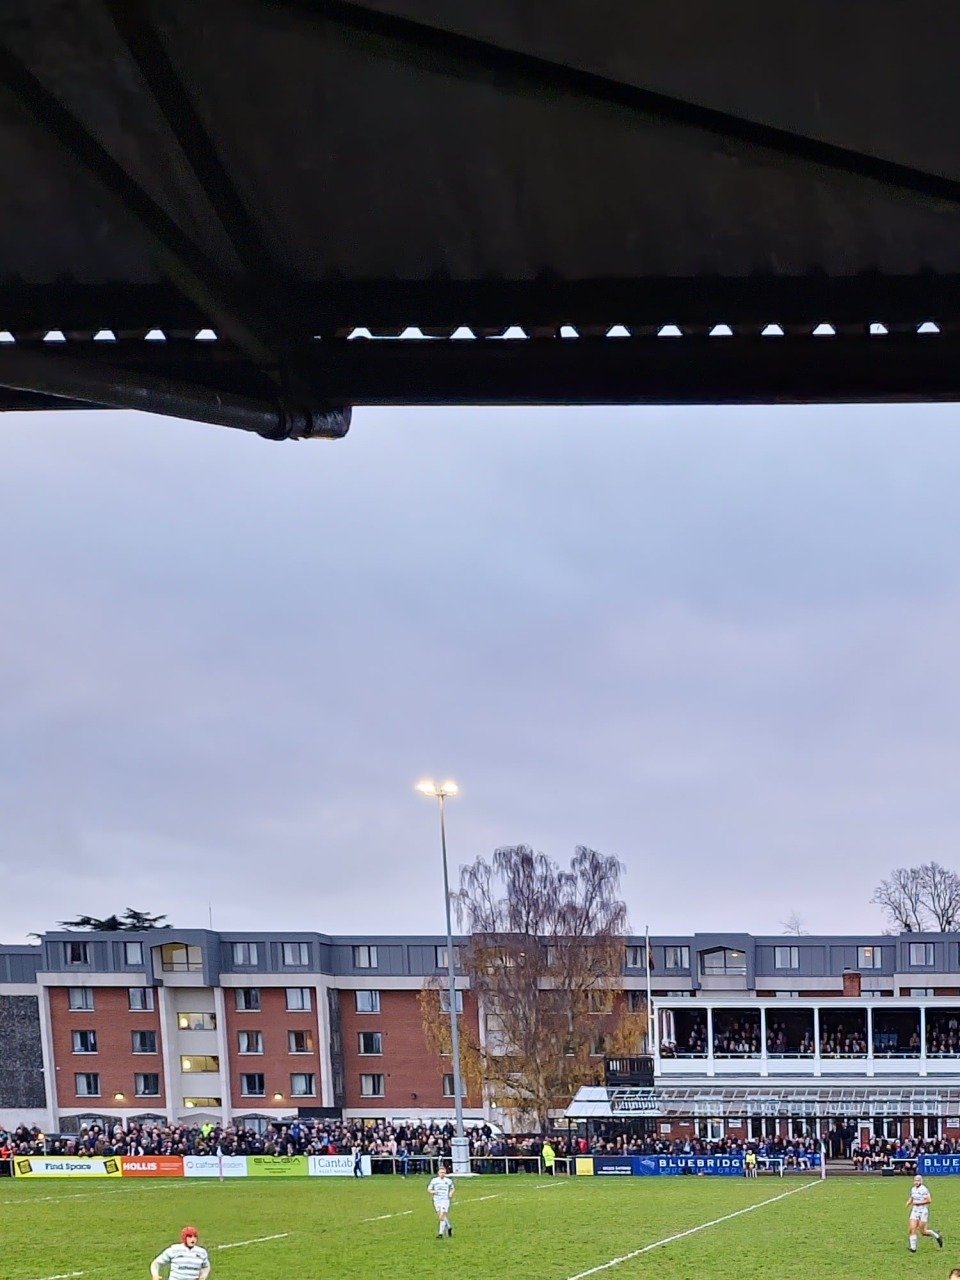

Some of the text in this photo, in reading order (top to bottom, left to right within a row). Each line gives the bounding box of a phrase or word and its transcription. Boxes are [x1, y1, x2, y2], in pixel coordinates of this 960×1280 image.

[122, 1162, 157, 1171] HOLLIS
[318, 1157, 353, 1168] Cantab
[65, 1163, 92, 1172] Space
